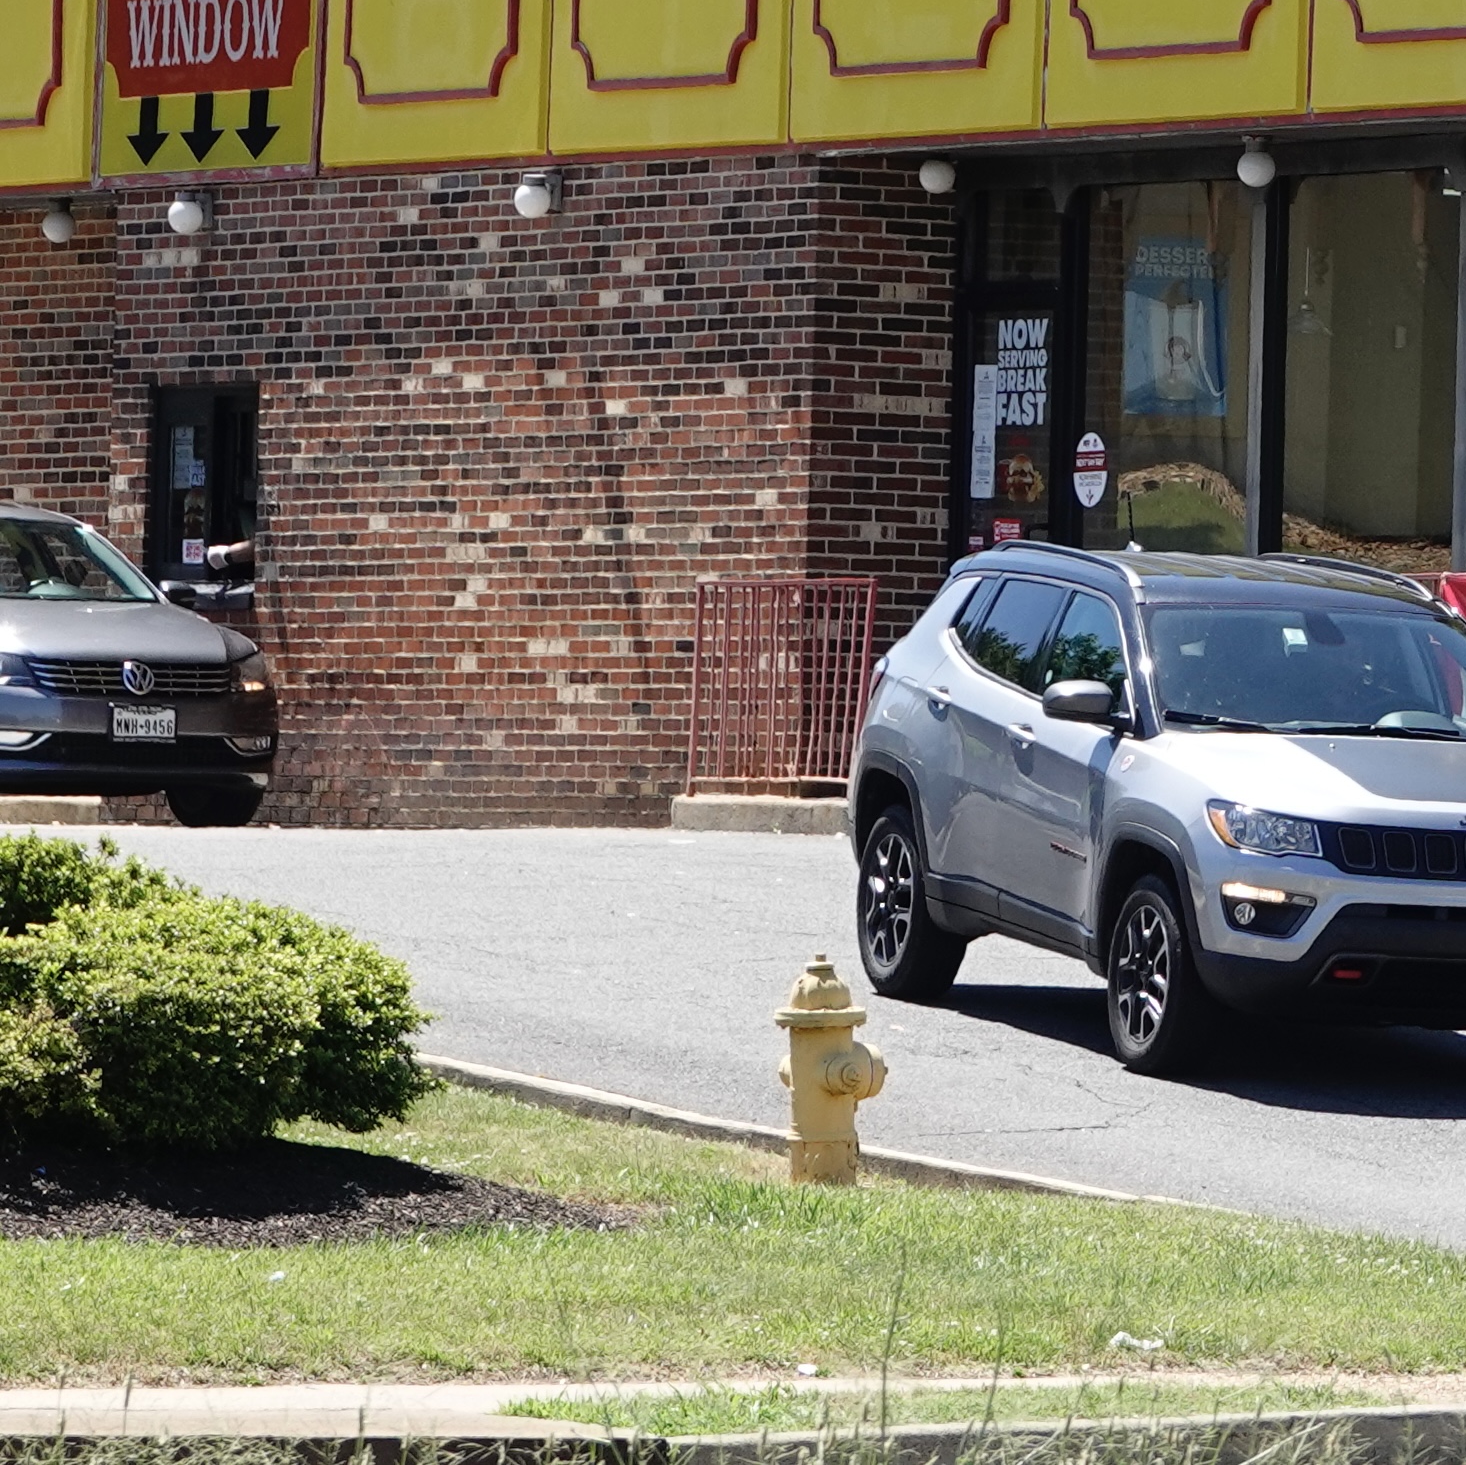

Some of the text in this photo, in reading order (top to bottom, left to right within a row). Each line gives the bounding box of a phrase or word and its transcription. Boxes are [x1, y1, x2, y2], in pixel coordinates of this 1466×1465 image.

[1135, 245, 1211, 265] DESSER
[998, 318, 1049, 350] NOW
[997, 348, 1048, 369] SERVING
[997, 367, 1047, 392] BREAK
[996, 391, 1047, 426] FAST
